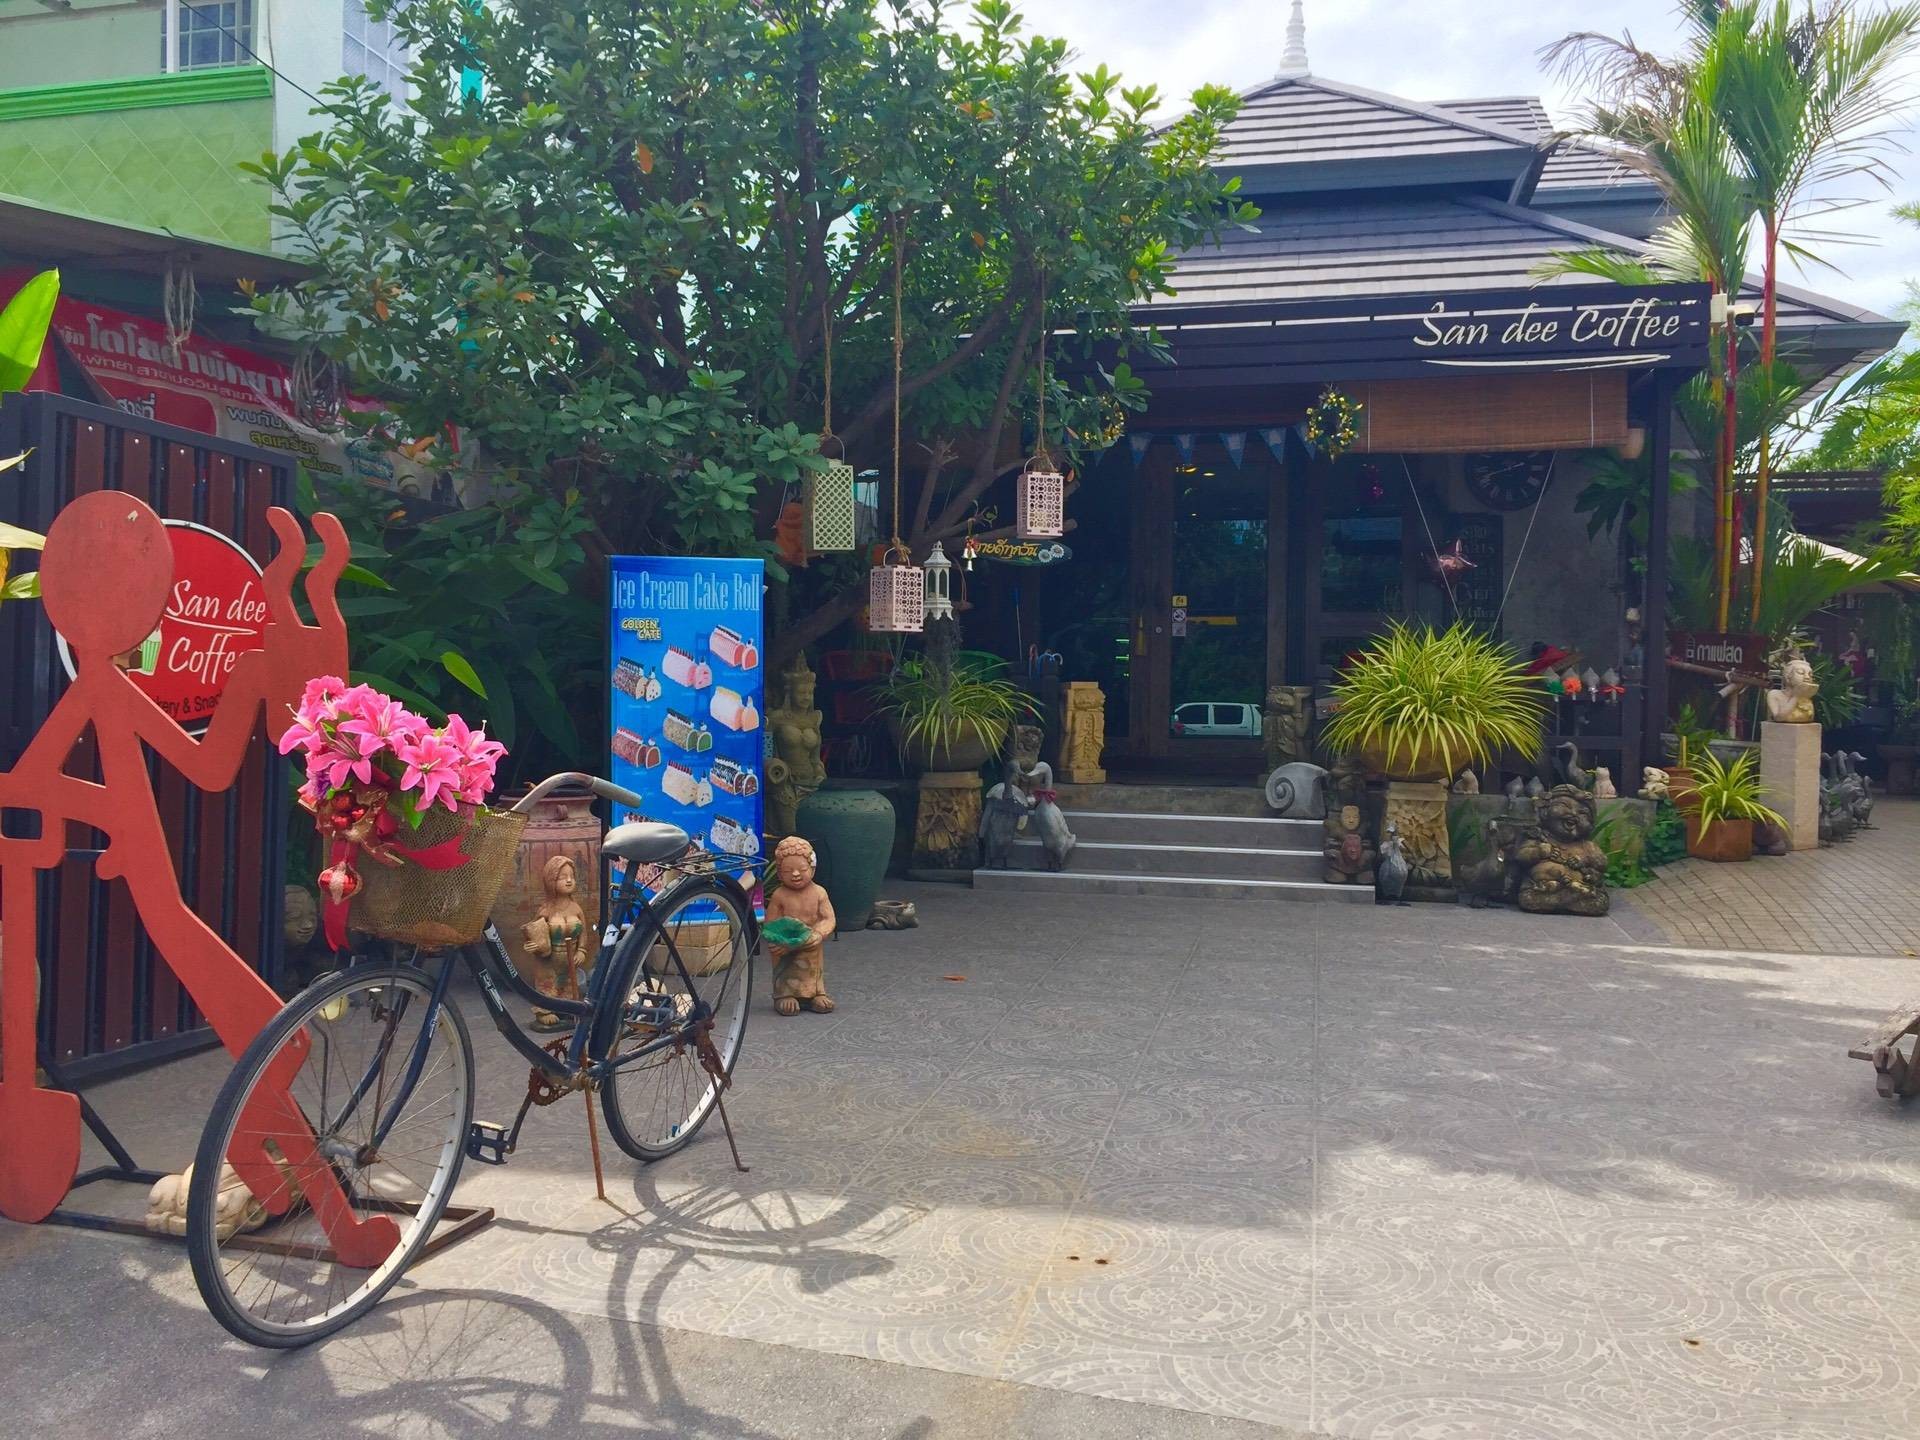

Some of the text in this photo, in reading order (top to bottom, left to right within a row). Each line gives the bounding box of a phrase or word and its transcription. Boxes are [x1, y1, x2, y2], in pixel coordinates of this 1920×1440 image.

[1413, 298, 1681, 347] San dee Coffee
[165, 579, 266, 623] San dee
[612, 570, 760, 611] Ice Cream Cake Roll
[622, 618, 659, 631] GOLDEN
[168, 632, 243, 685] Coffe
[182, 697, 191, 714] &
